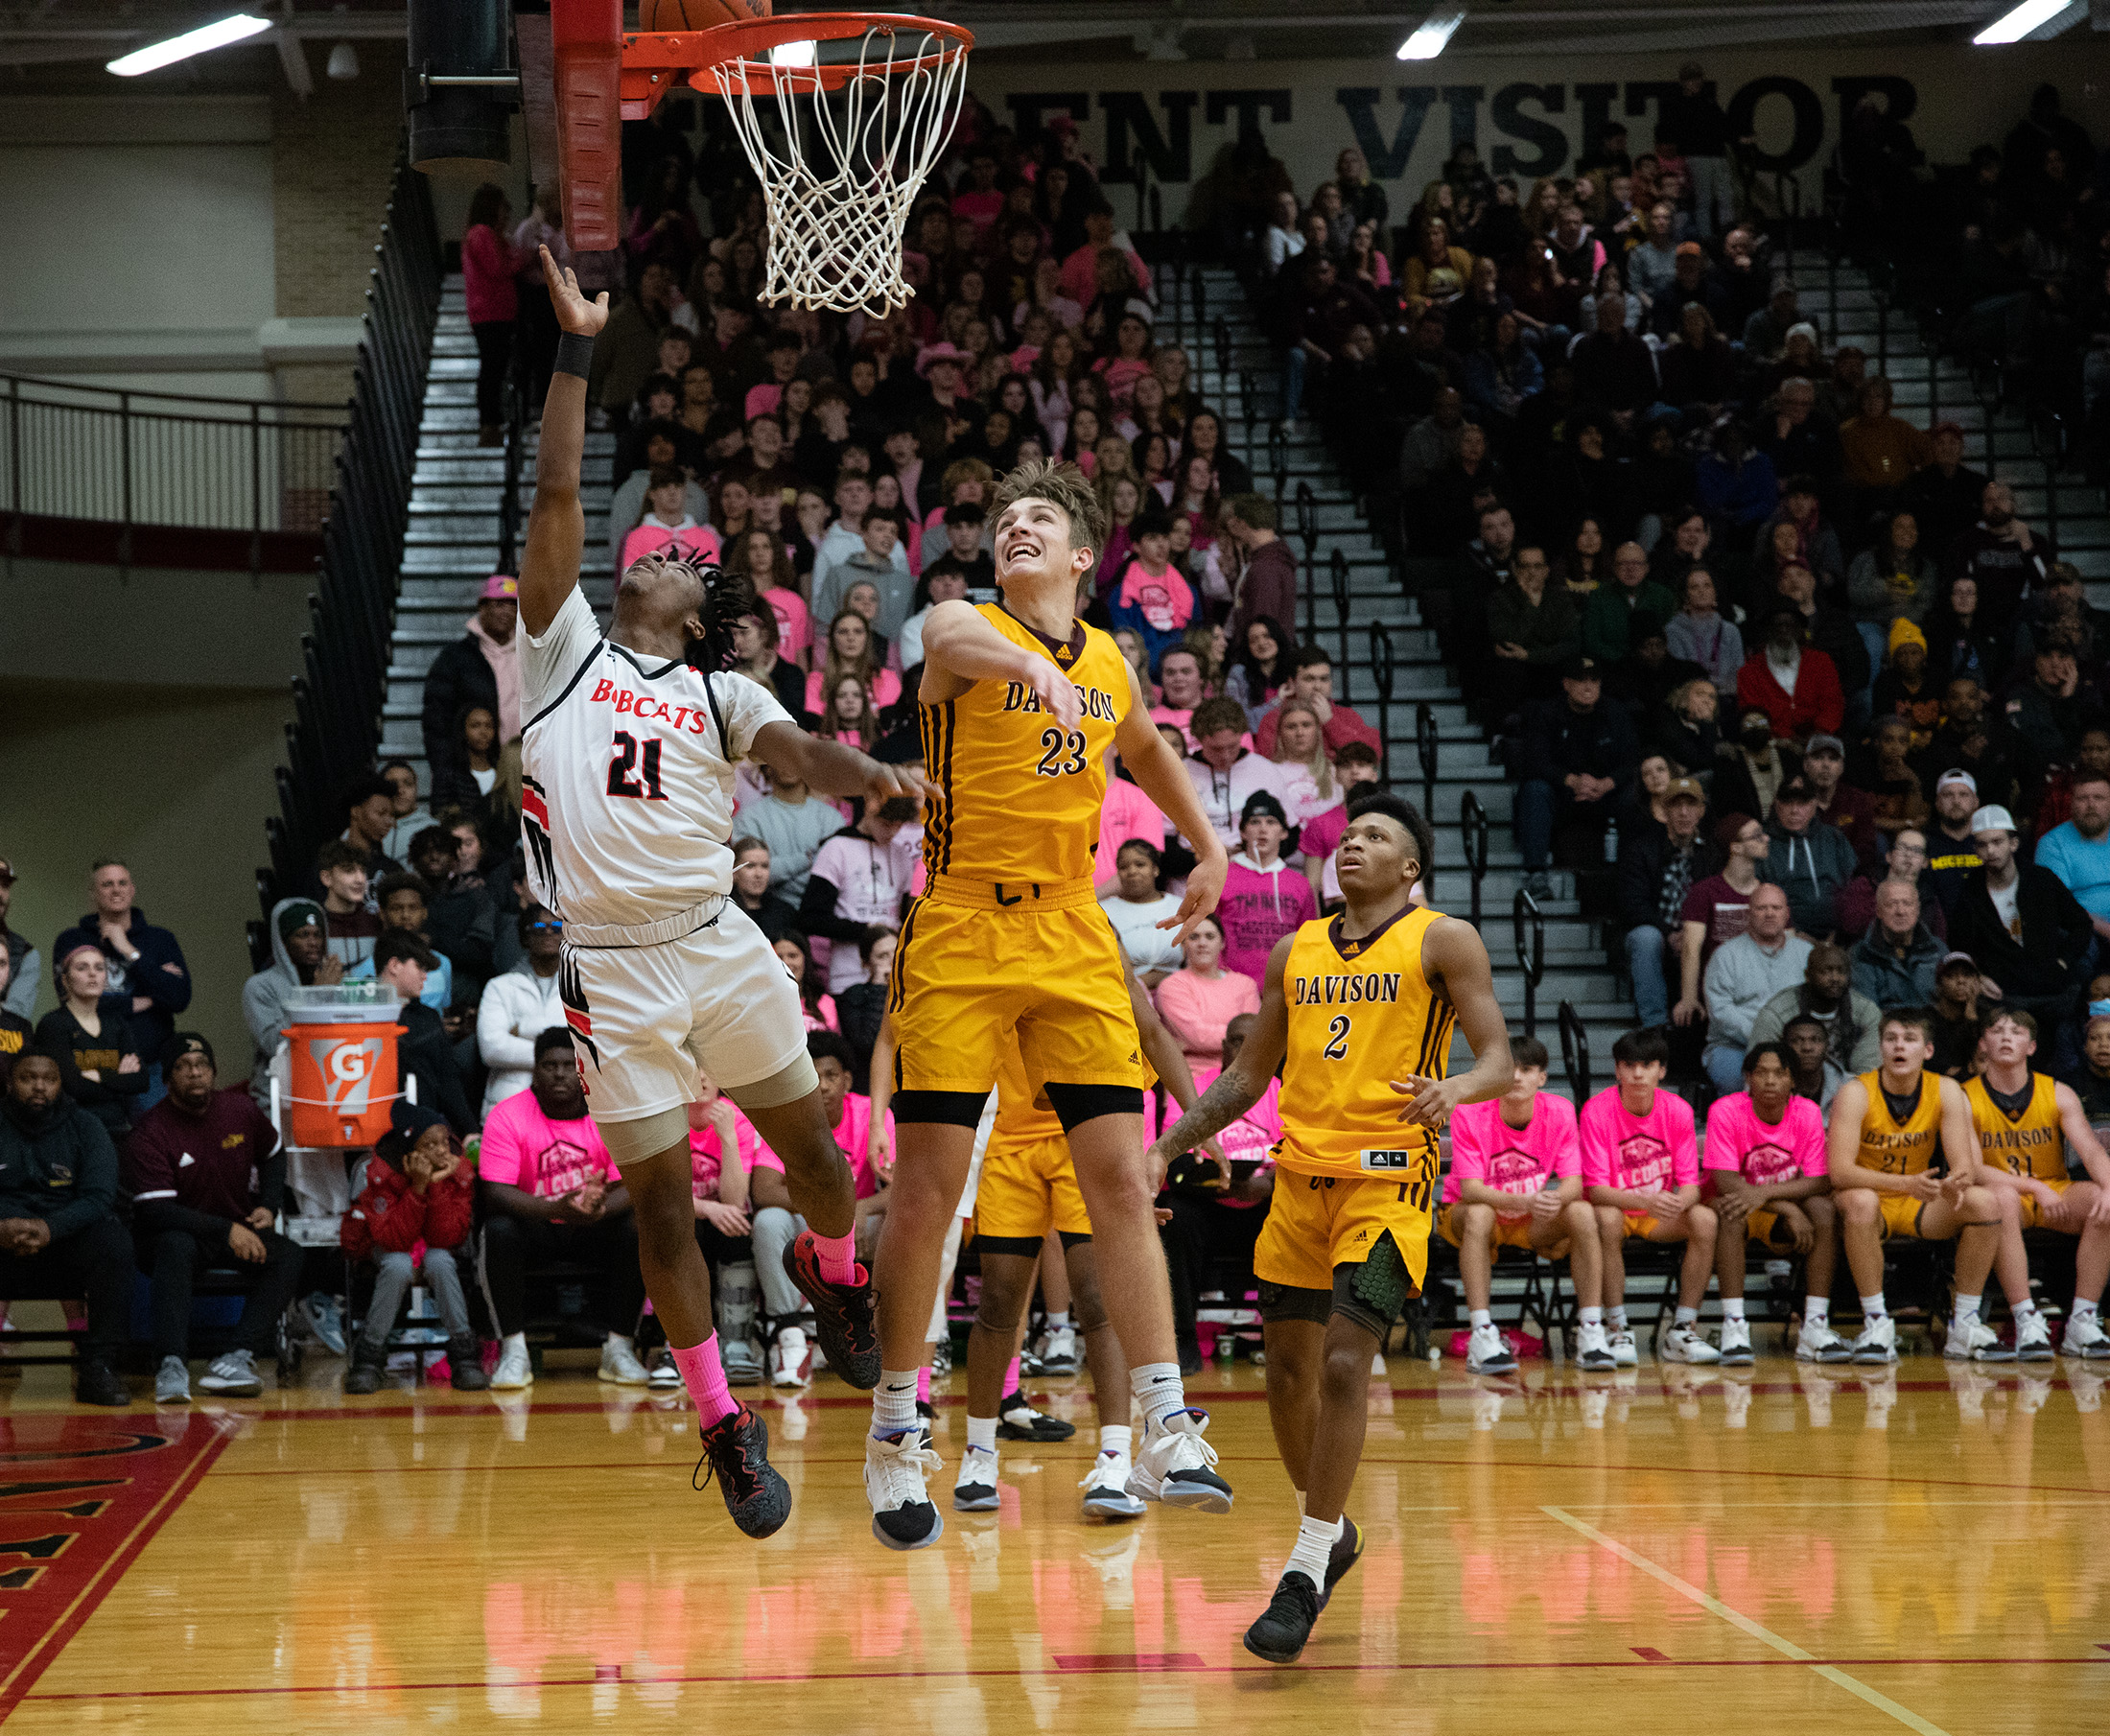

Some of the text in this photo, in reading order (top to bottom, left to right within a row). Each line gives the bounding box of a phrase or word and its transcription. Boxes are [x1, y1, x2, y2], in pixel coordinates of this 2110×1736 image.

[1001, 679, 1117, 724] DASON
[606, 730, 669, 801] 21
[1036, 726, 1088, 778] 23
[1296, 972, 1401, 1006] DAVISON
[1323, 1014, 1351, 1061] 2
[331, 1044, 364, 1081] G
[1982, 1126, 2052, 1149] DAVISON
[1882, 1153, 1908, 1175] 21
[2005, 1153, 2032, 1178] 31
